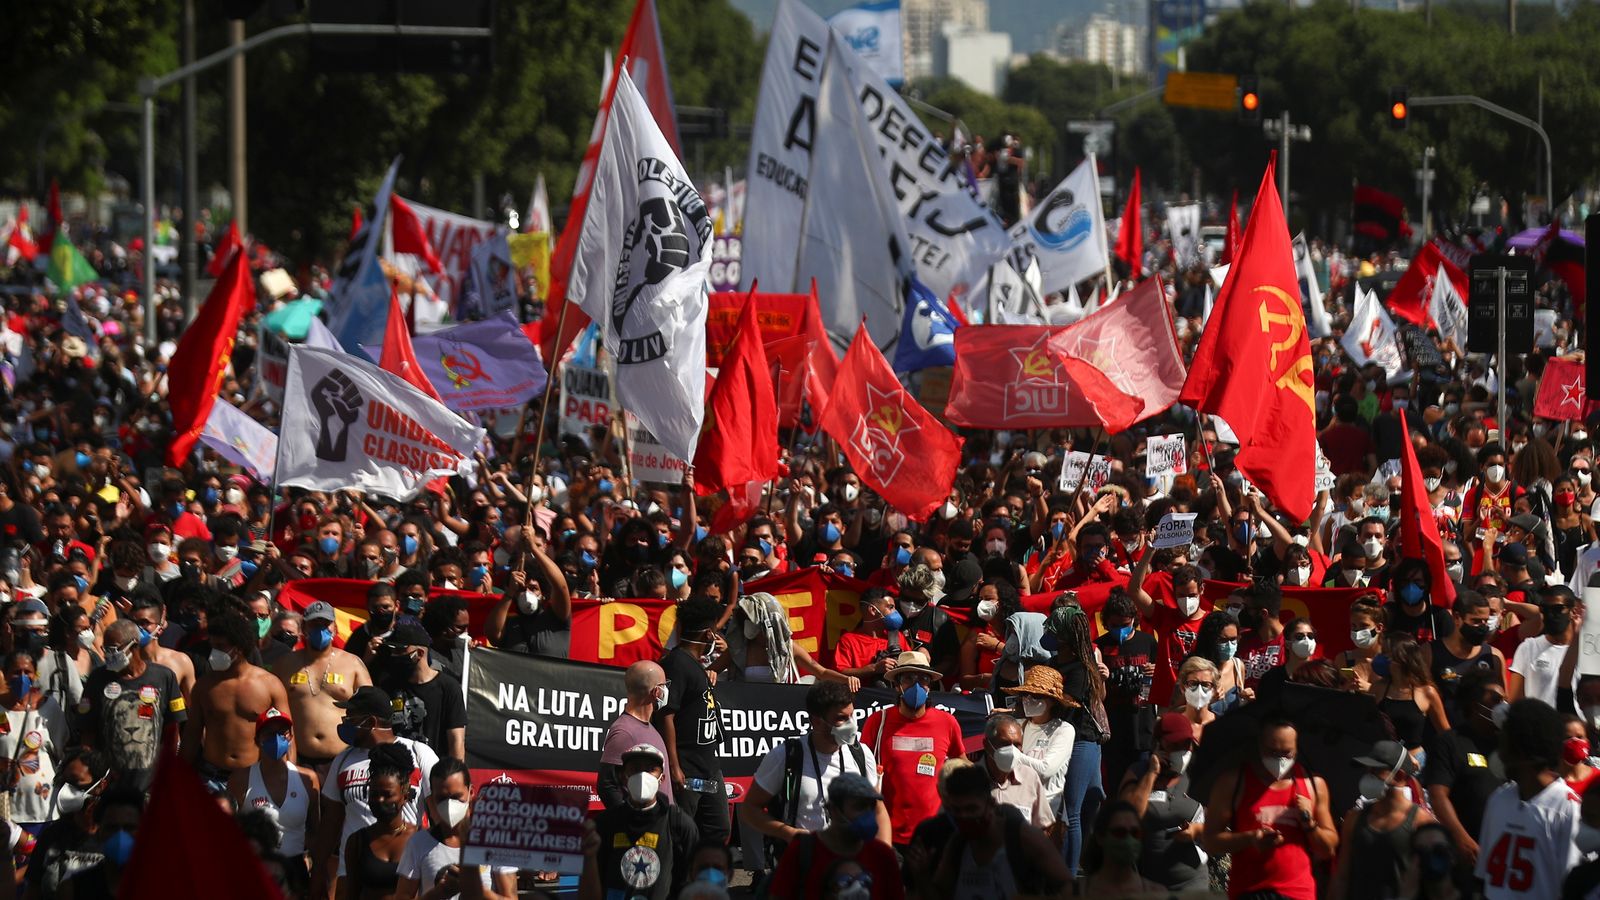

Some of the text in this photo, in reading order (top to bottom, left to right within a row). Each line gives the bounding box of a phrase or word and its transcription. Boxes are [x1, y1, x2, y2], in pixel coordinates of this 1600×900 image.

[638, 158, 706, 214] OLETIVO
[619, 332, 664, 362] OLIV
[1070, 459, 1109, 471] FASISTAS
[1155, 530, 1192, 540] OLSONARO
[1160, 518, 1187, 532] FORA
[498, 681, 531, 712] NA
[537, 687, 596, 721] LUTA
[721, 708, 814, 735] EDUCAÇ
[505, 717, 611, 752] GRATUIT
[478, 786, 522, 801] FORA
[471, 813, 549, 833] MOURÃO
[473, 801, 585, 823] BOLSONARO,
[469, 828, 583, 850] E MILITARES!
[1486, 831, 1537, 893] 45
